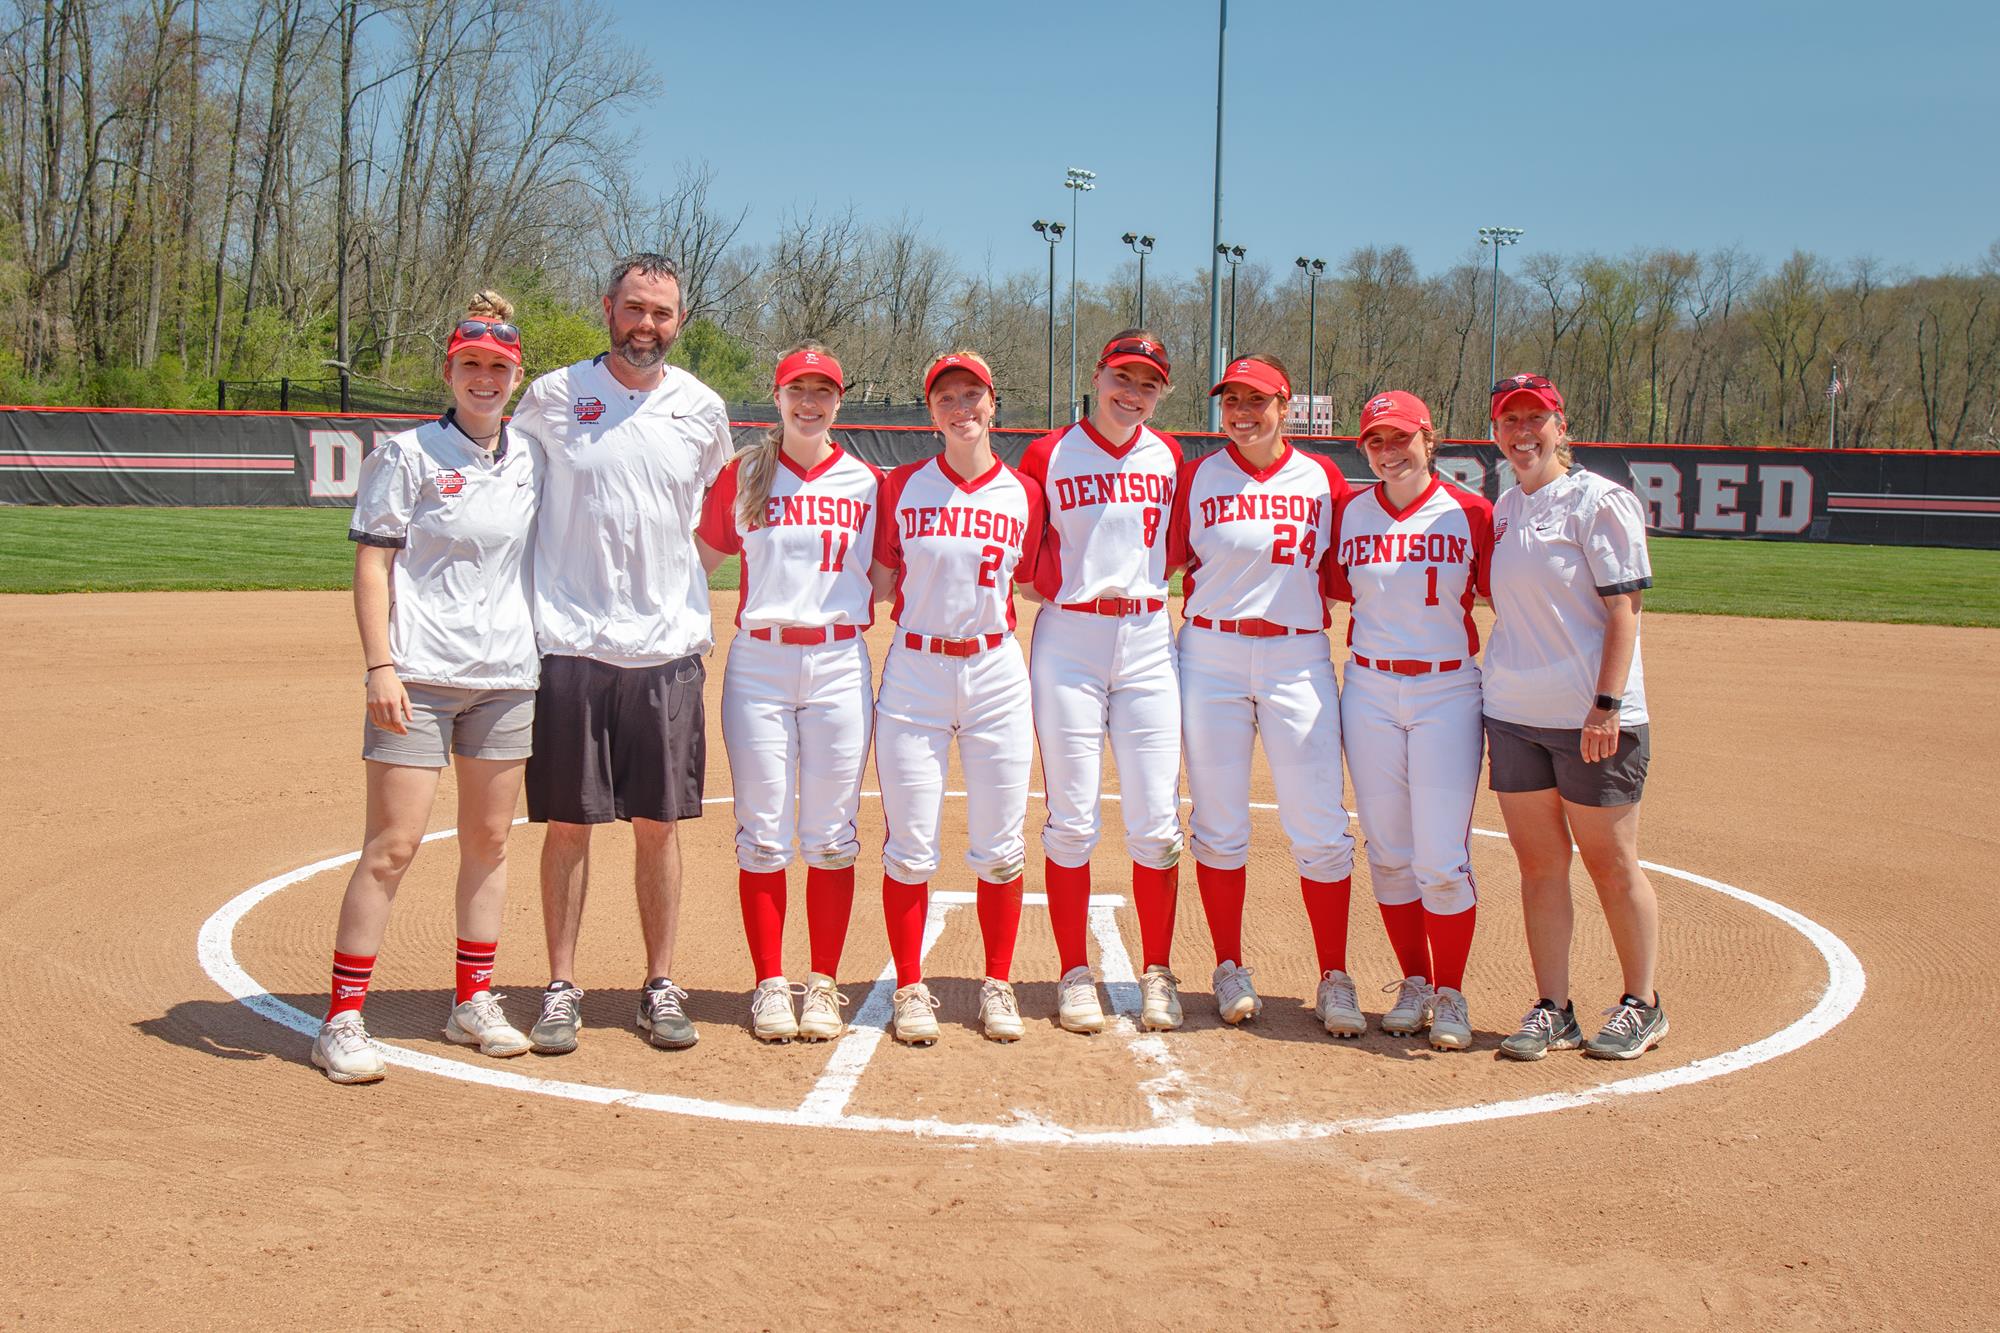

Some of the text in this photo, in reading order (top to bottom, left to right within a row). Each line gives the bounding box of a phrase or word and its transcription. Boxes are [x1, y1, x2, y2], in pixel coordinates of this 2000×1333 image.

[1055, 472, 1173, 512] DENISON
[1199, 494, 1322, 529] DENISON
[1629, 461, 1814, 534] RED
[900, 506, 1025, 548] DENISON
[1143, 506, 1162, 549] 8
[1271, 523, 1317, 568] 24
[820, 530, 849, 572] 11
[978, 544, 1005, 588] 2
[1425, 566, 1439, 606] 1
